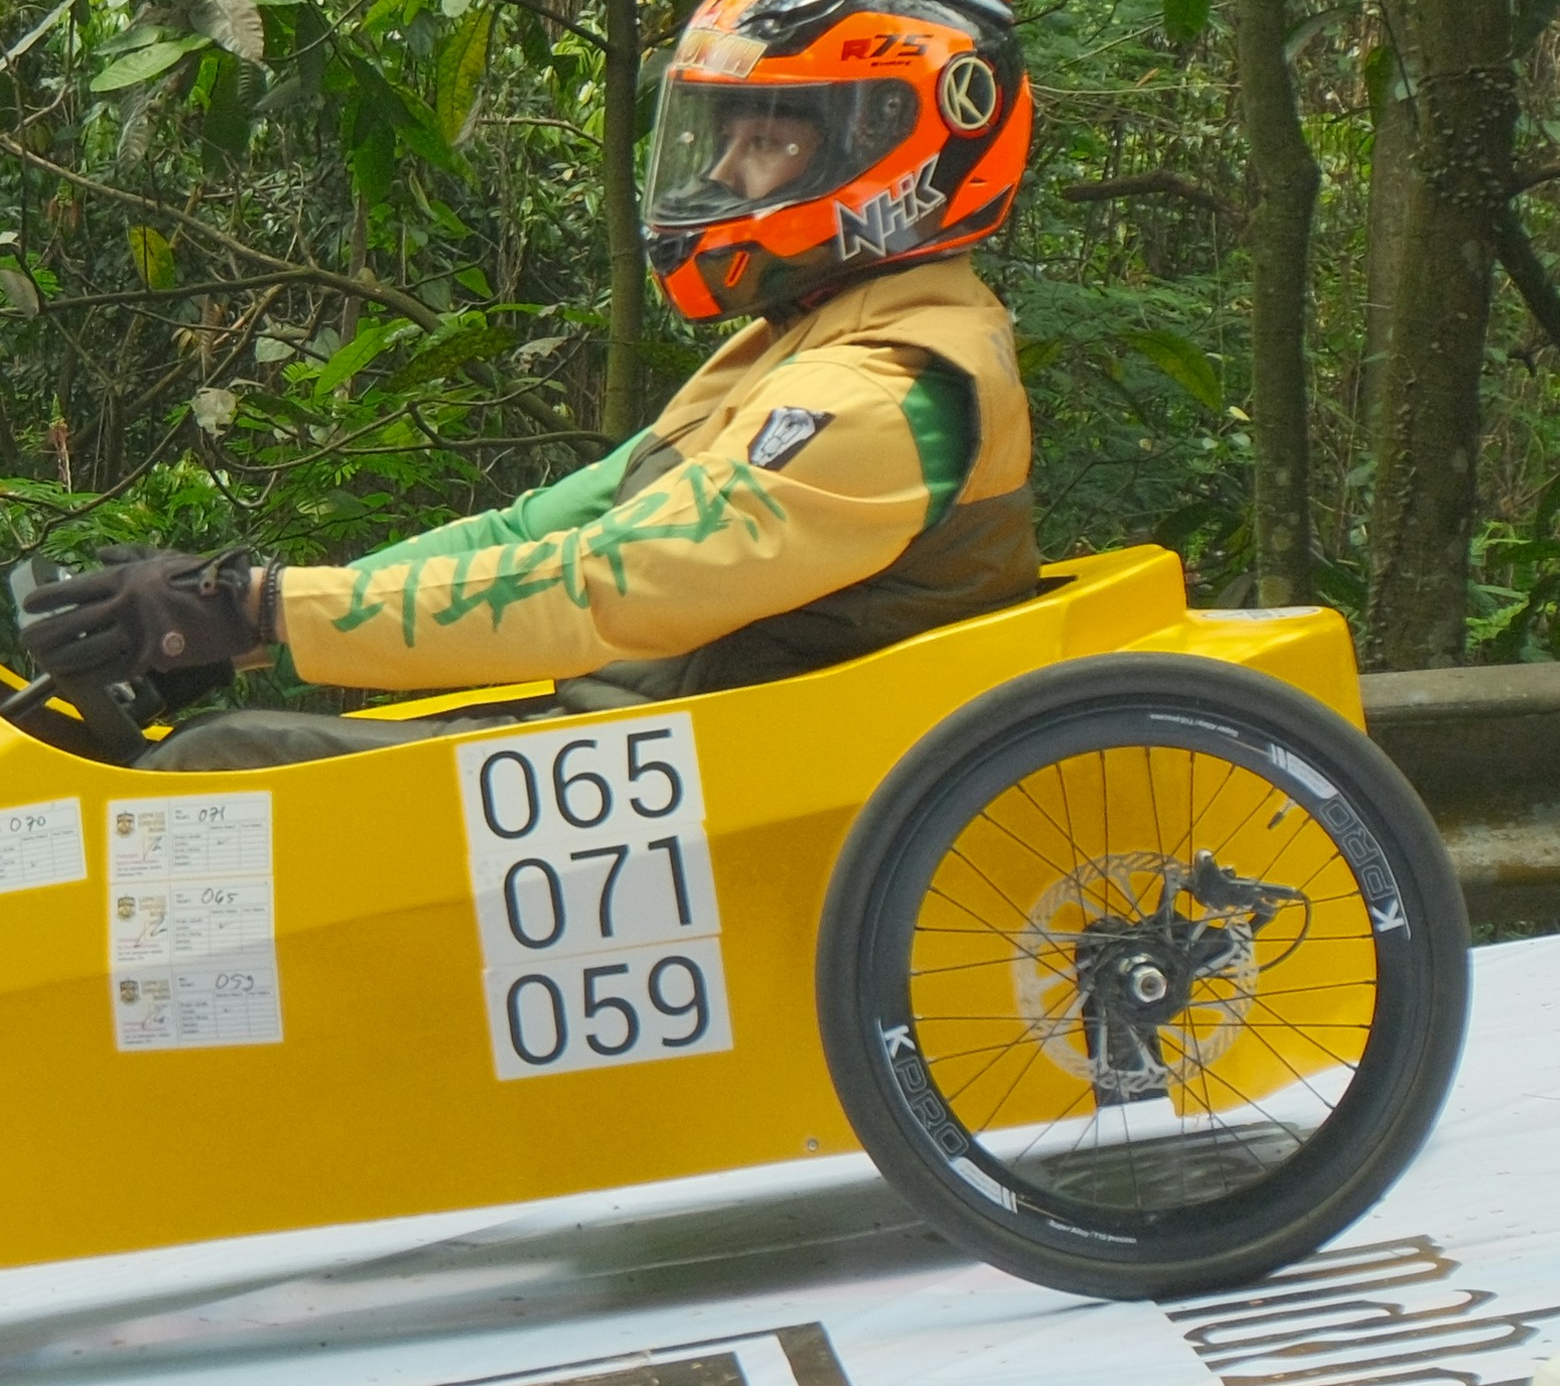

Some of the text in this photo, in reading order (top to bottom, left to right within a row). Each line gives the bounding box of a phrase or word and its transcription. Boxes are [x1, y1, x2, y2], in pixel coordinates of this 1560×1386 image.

[480, 727, 684, 841] 065
[201, 887, 238, 905] 065
[503, 835, 692, 950] 071
[506, 955, 710, 1066] 059
